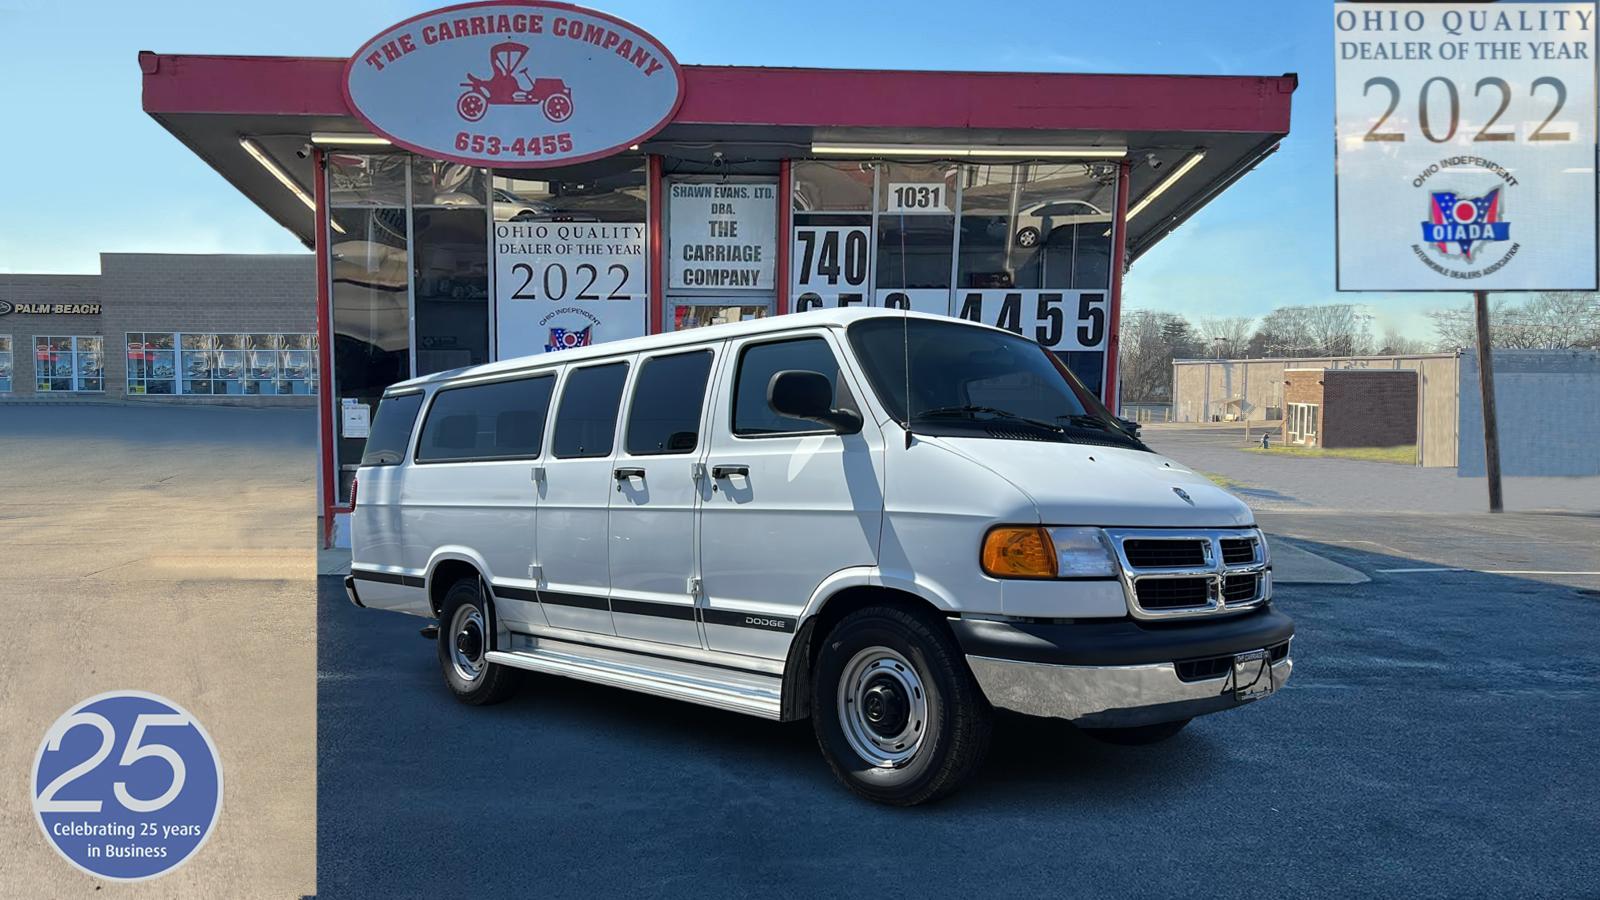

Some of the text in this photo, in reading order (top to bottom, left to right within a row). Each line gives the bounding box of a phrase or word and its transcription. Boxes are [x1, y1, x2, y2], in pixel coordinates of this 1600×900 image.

[1336, 10, 1592, 35] OHIO QUALITY
[365, 15, 664, 77] THE CARRIAGE COMPANY
[1340, 42, 1589, 60] DEALER OF THE YEAR
[1362, 76, 1571, 143] 2022
[455, 132, 573, 156] 653-4455
[1412, 156, 1519, 188] OHIO INDEPENDENT
[672, 186, 712, 198] SHAWN
[753, 188, 775, 199] LTD.
[894, 187, 941, 208] 1031
[711, 203, 736, 215] DBA.
[497, 226, 643, 240] OHIO QUALITY
[708, 221, 738, 237] THE
[1432, 225, 1495, 240] OIADA
[500, 244, 641, 255] DEALER OF THE YEAR
[682, 245, 762, 262] CARRIAGE
[797, 230, 868, 286] 740
[1411, 244, 1449, 276] AUTOMOBILE
[1483, 242, 1521, 276] ASSOCIATION
[511, 263, 632, 301] 2022
[683, 269, 760, 286] COMPANY
[14, 304, 100, 314] PALM BEACH
[555, 307, 601, 326] INDEPENDENT
[745, 616, 784, 627] DODGE
